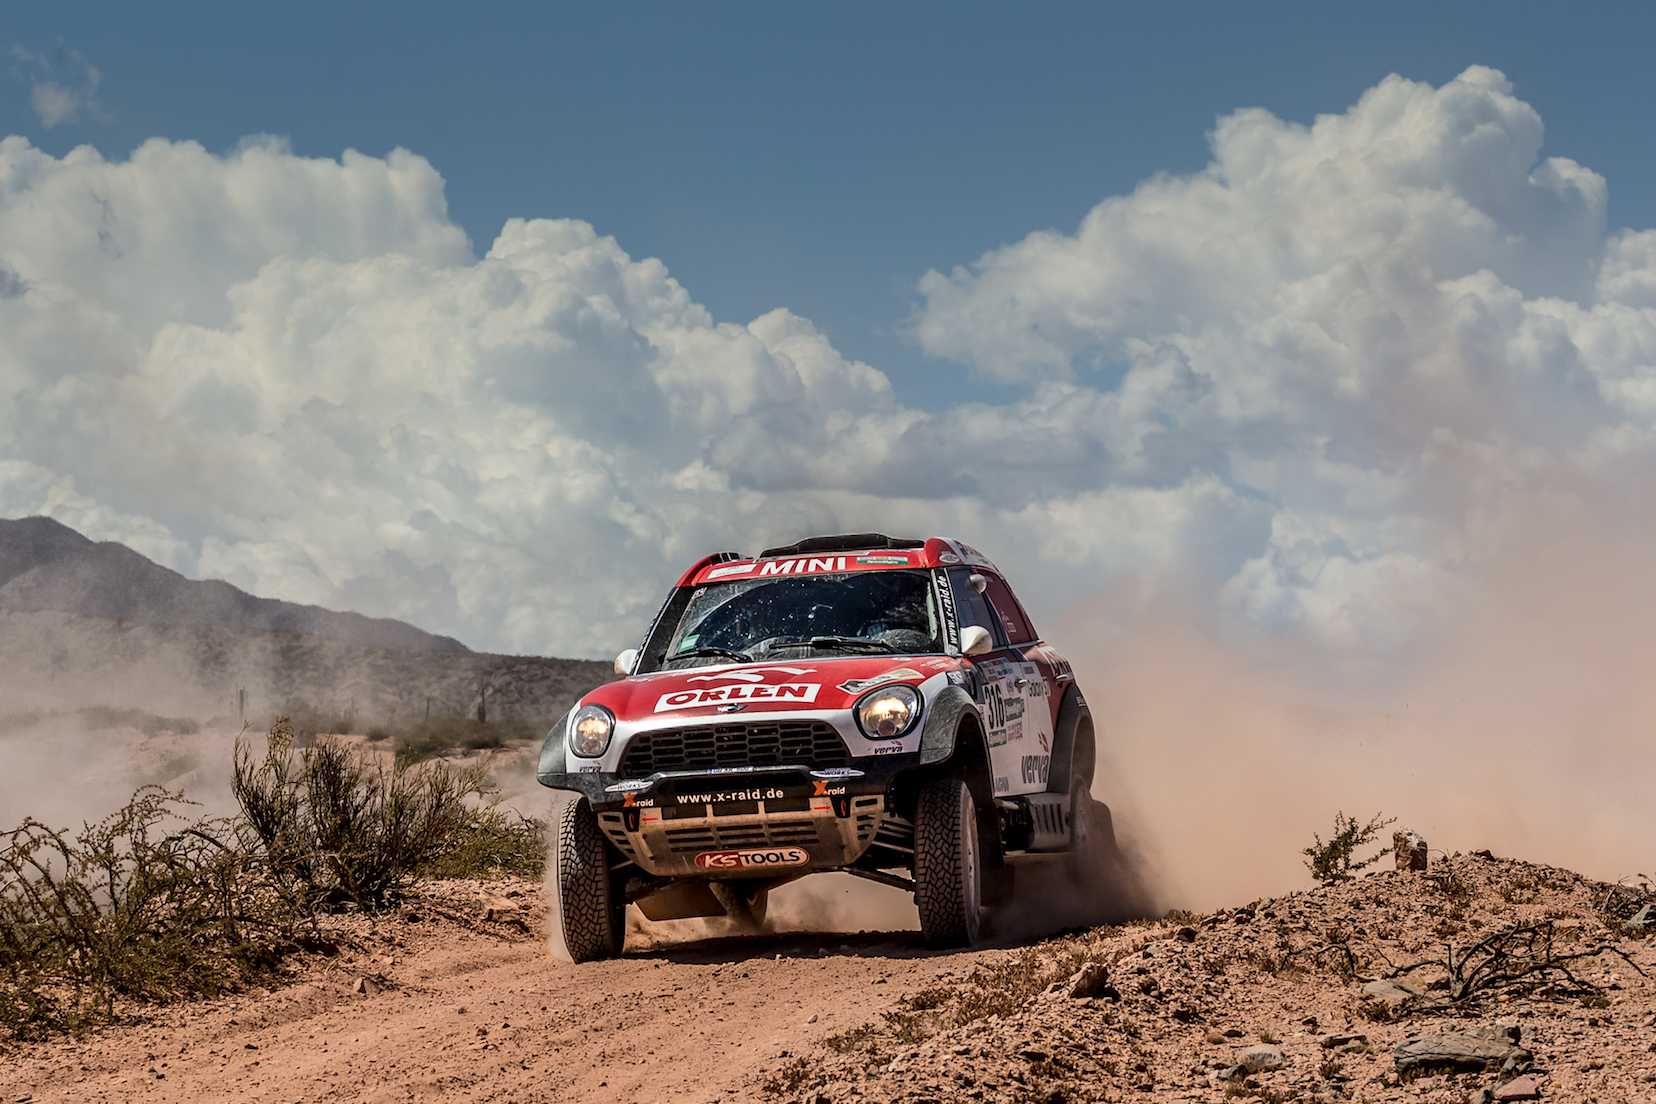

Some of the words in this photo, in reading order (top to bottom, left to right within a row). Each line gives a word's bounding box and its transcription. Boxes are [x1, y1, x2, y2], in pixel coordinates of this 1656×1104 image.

[759, 556, 846, 576] MINI
[665, 685, 810, 705] ORLEN
[983, 682, 1006, 730] 316
[1021, 755, 1051, 784] verva
[676, 788, 785, 804] www.x-raid.de
